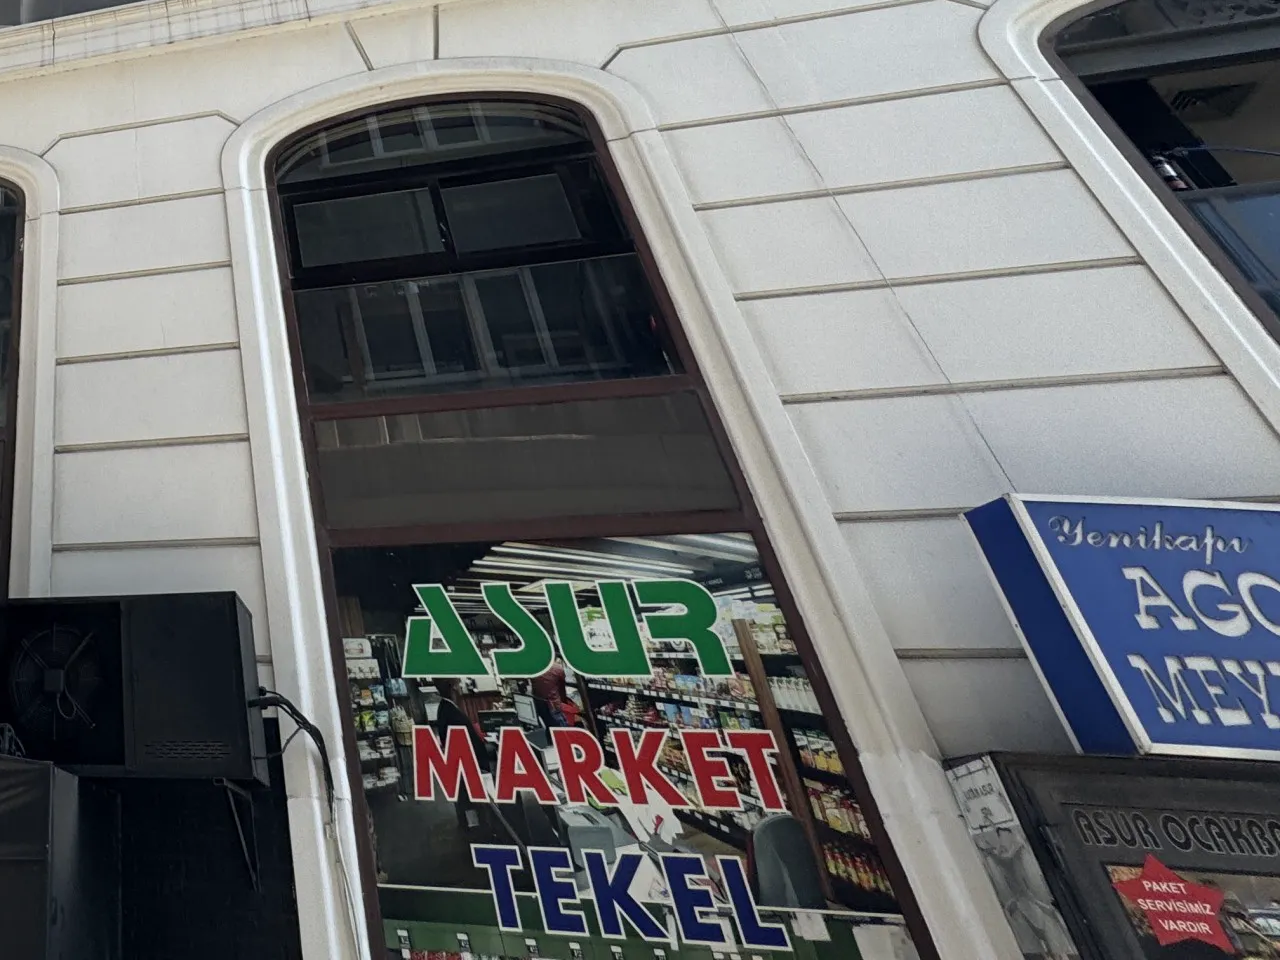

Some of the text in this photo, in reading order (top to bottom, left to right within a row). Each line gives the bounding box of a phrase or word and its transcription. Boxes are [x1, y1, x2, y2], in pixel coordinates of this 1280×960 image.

[402, 578, 737, 677] ASUR
[1127, 654, 1280, 729] MEY
[412, 725, 789, 812] MARKET
[1073, 808, 1163, 850] ASUR
[470, 843, 792, 952] TEKEL
[1142, 880, 1188, 895] PAKET
[1158, 918, 1213, 935] VARDIR
